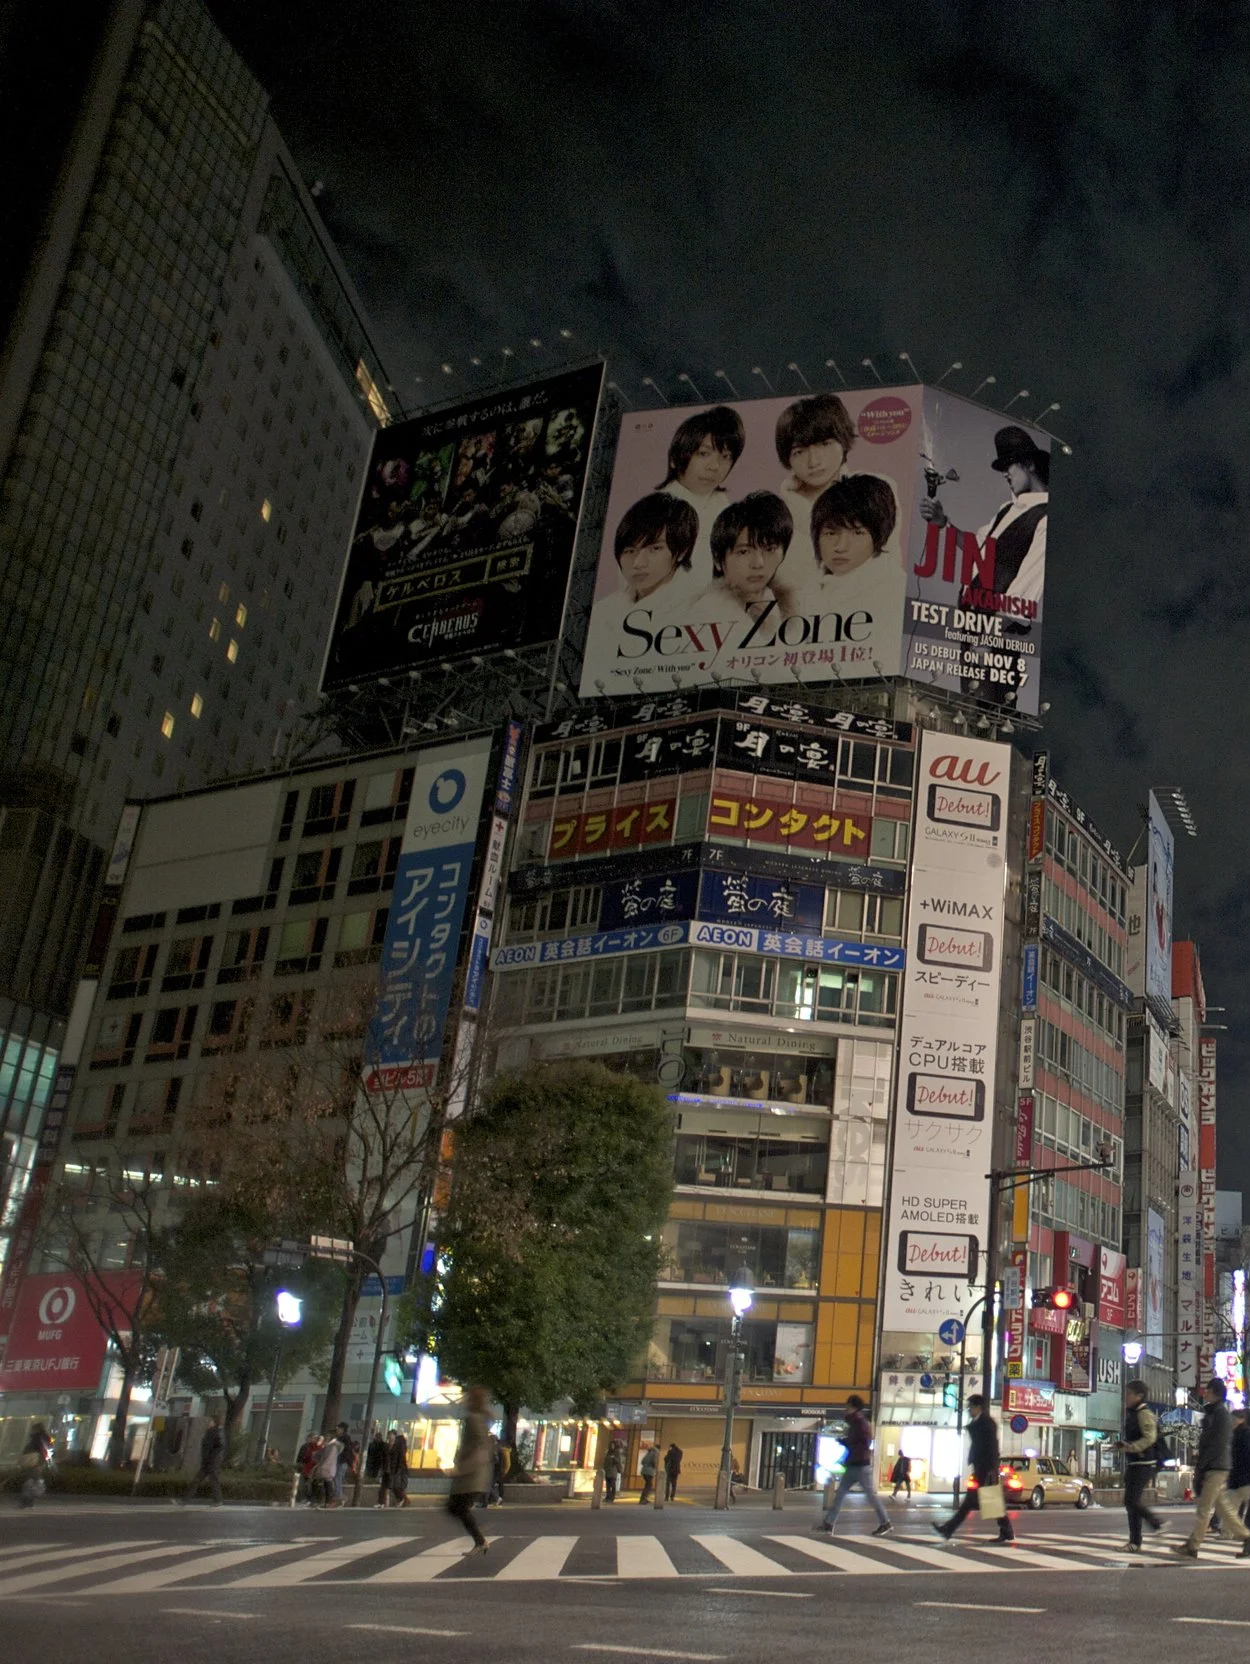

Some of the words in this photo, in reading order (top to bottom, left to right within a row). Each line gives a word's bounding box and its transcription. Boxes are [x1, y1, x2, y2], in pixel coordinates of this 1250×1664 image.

[914, 522, 997, 590] JIN
[961, 585, 1038, 620] AKANISHI
[911, 601, 949, 626] TEST
[953, 609, 1003, 637] DRIVE
[617, 609, 738, 670] Sexy
[738, 598, 873, 649] Zone
[945, 626, 979, 646] featuring
[980, 634, 1004, 649] JASON
[1006, 640, 1035, 655] DERULO
[915, 642, 928, 655] US
[931, 645, 961, 660] DEBUT
[964, 651, 979, 664] ON
[983, 651, 1013, 669] NOV
[1017, 658, 1027, 672] 8
[911, 657, 944, 673] JAPAN
[947, 663, 986, 681] RELEASE
[990, 667, 1016, 685] DEC
[1019, 673, 1029, 687] 7
[735, 722, 750, 733] 9F
[928, 755, 1002, 787] au
[936, 796, 991, 818] Debut!
[413, 815, 470, 838] eyecity
[552, 803, 672, 849] プライス
[711, 798, 866, 848] コンタクト
[925, 827, 959, 839] GALAXY
[681, 848, 694, 860] 7F
[709, 848, 723, 860] 7F
[919, 898, 993, 921] +WiMAX
[543, 930, 655, 961] 英会話イーオン
[662, 929, 679, 942] 6F
[697, 925, 752, 948] AEON
[928, 935, 982, 958] Debut!
[495, 945, 536, 966] AEON
[763, 934, 900, 967] 英会話イーオン
[915, 970, 990, 991] スピーディー
[612, 1034, 643, 1044] Dining
[728, 1033, 772, 1046] Natural
[777, 1037, 816, 1051] Dining
[910, 1036, 986, 1056] デュアルコア
[909, 1052, 985, 1074] CPU搭載
[918, 1083, 974, 1107] Debut!
[904, 1118, 984, 1144] サクサク
[902, 1196, 919, 1207] HD
[923, 1197, 967, 1211] SUPER
[900, 1209, 979, 1226] AMOLED搭載
[909, 1243, 967, 1265] Debut!
[899, 1278, 974, 1304] きれい
[1101, 1278, 1119, 1303] アコム
[38, 1329, 62, 1341] MUFG
[1180, 1301, 1193, 1373] マルナン
[1097, 1359, 1121, 1385] USH
